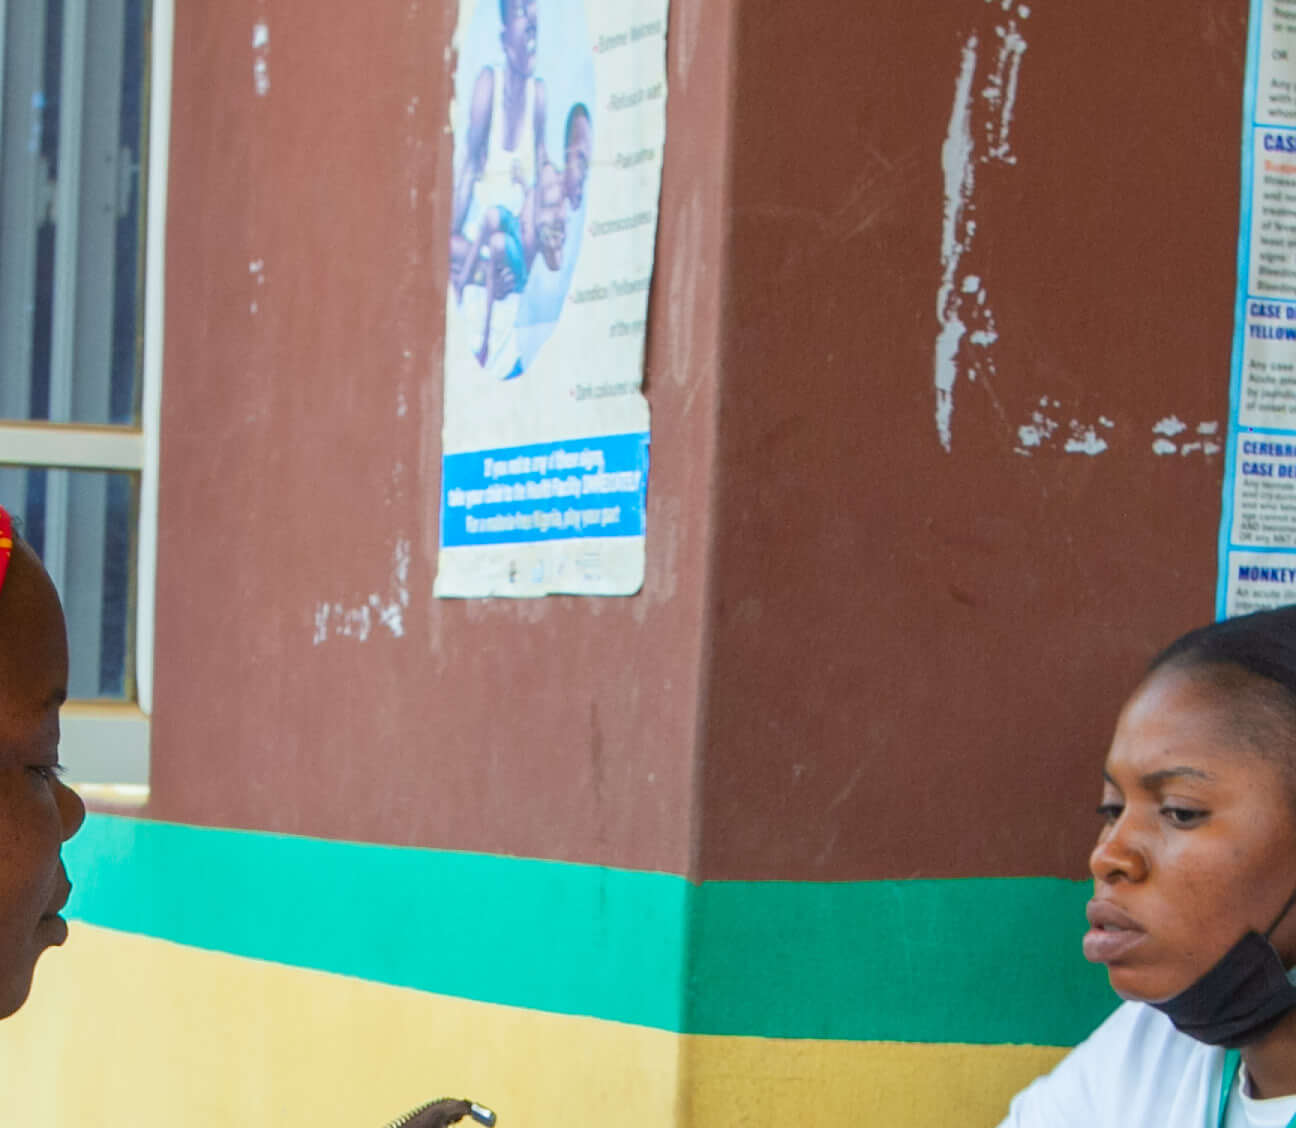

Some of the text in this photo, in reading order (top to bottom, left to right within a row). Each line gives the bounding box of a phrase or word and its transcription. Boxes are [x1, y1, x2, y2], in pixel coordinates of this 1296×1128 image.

[1250, 303, 1281, 319] CASE
[1250, 324, 1296, 342] YELLOW
[1242, 461, 1273, 477] CASE
